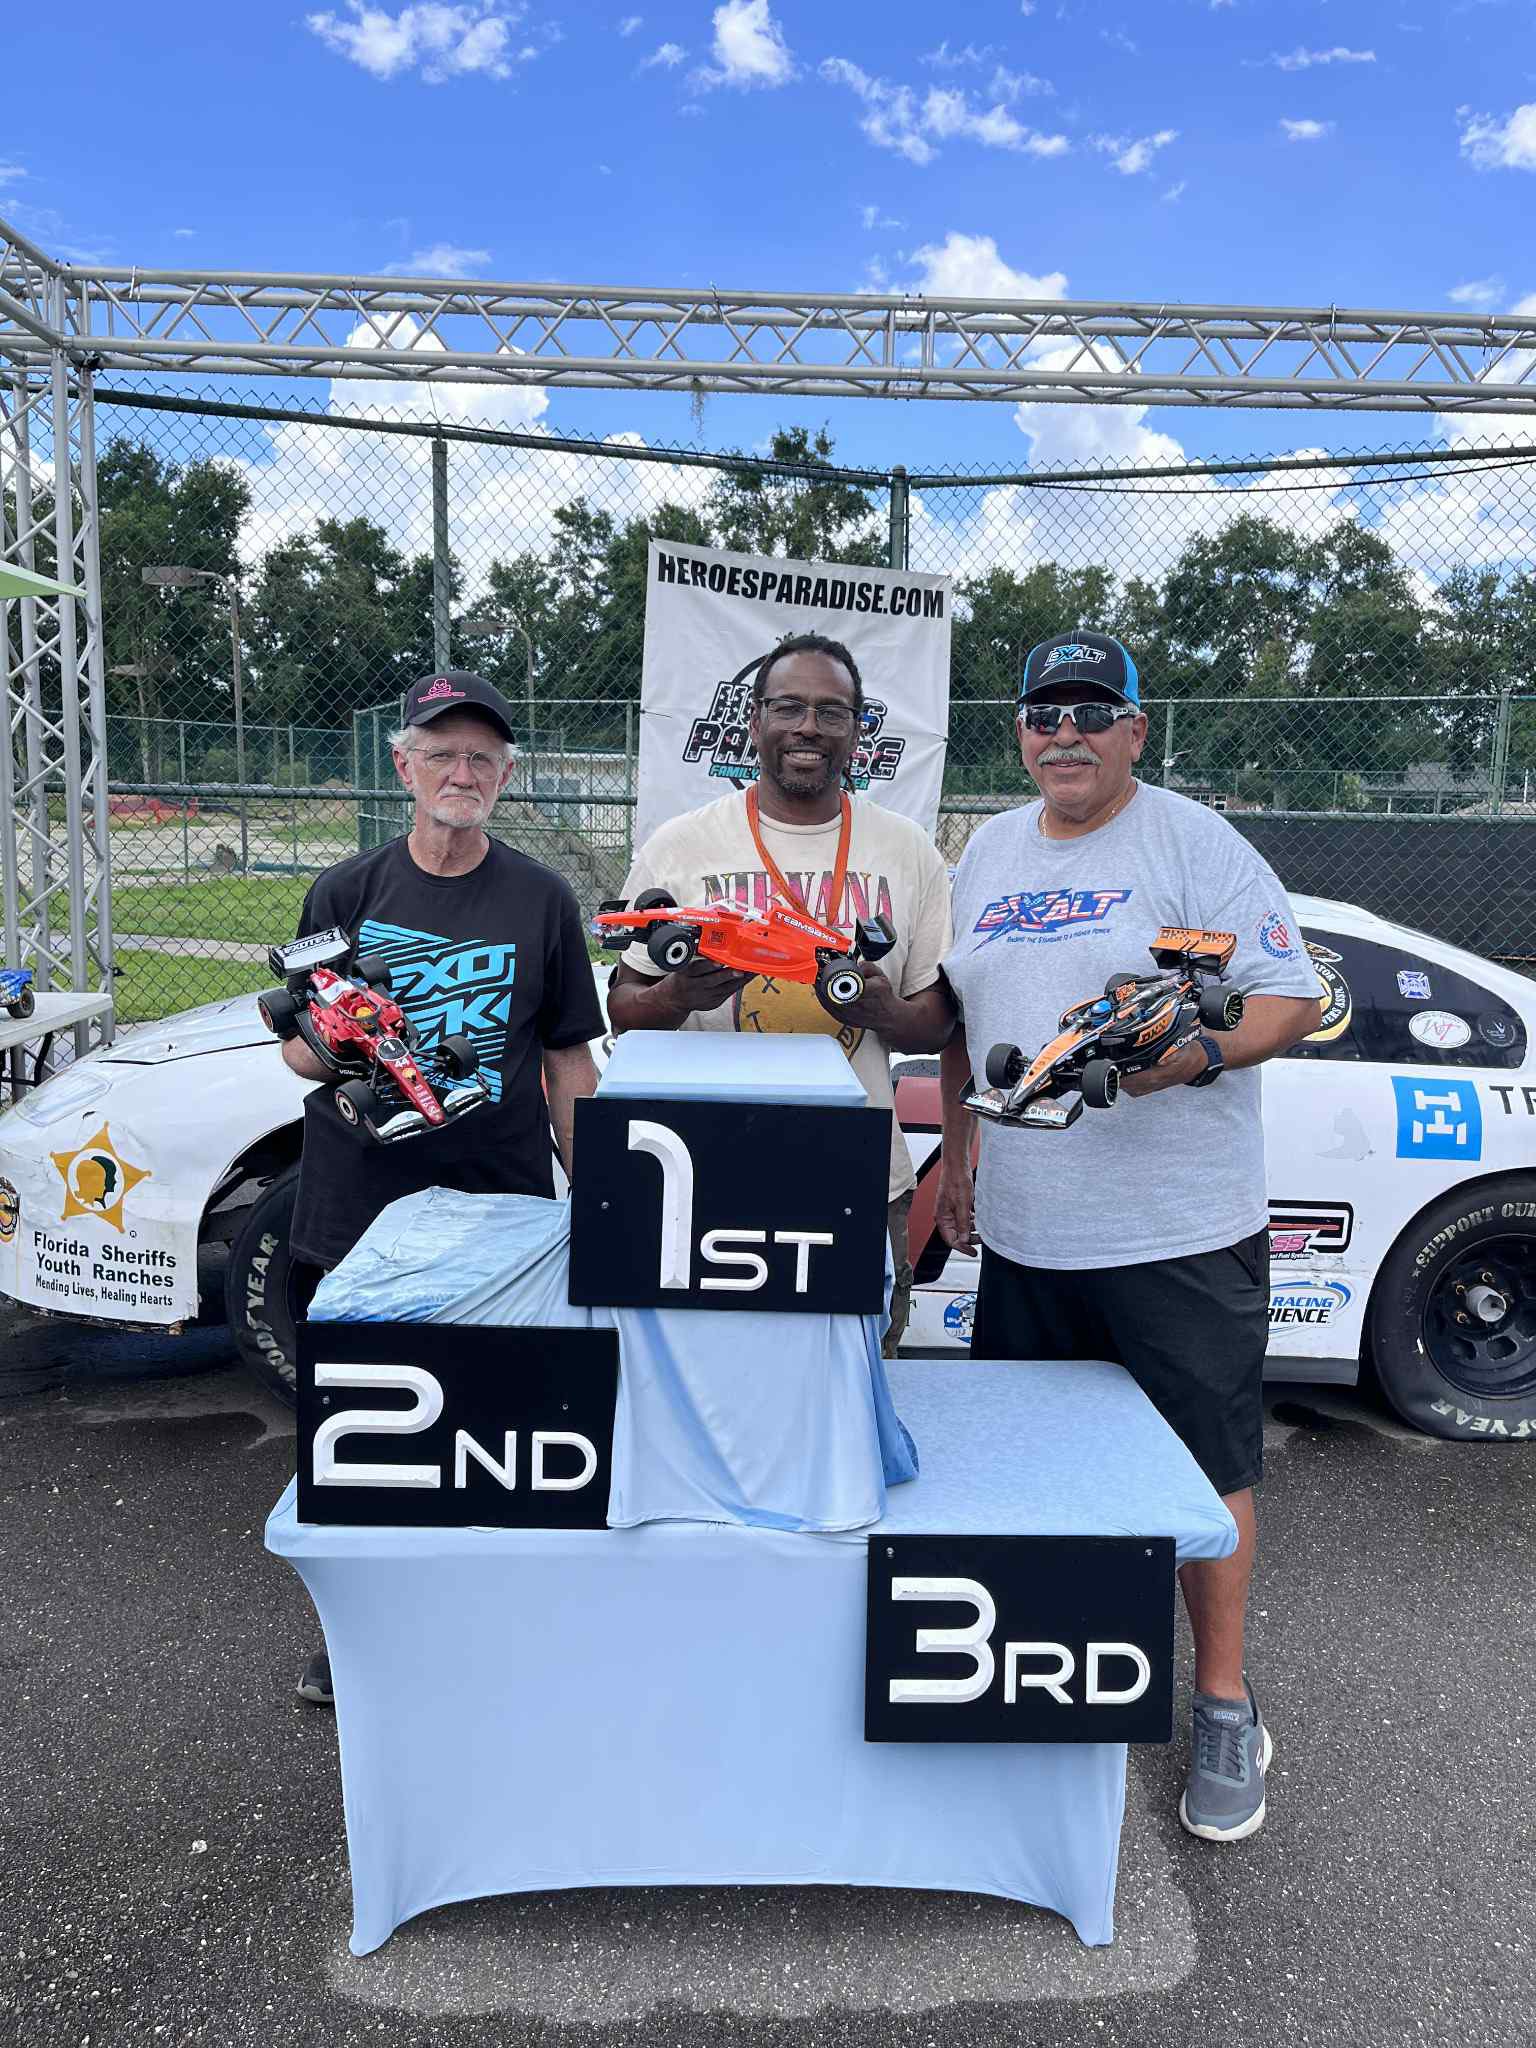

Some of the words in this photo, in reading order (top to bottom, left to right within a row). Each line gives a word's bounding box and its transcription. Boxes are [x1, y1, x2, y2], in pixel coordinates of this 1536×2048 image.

[657, 552, 945, 618] HEROESPARADISE.COM
[1044, 644, 1106, 668] EXALT
[683, 719, 904, 780] PASE
[973, 889, 1132, 933] EXALT
[1313, 961, 1337, 982] ATOR
[627, 1119, 834, 1293] 1ST
[34, 1231, 89, 1258] Florida
[101, 1244, 177, 1268] Sheriffs
[1415, 1205, 1495, 1268] SUPPORT
[35, 1274, 69, 1296] Mending
[72, 1281, 98, 1301] Lives,
[101, 1287, 137, 1306] Healing
[140, 1291, 173, 1306] Hearts
[36, 1252, 81, 1276] Youth
[93, 1263, 174, 1287] Ranches
[246, 1233, 297, 1391] OODYEAR
[1268, 1308, 1331, 1323] RIENCE
[1272, 1296, 1335, 1308] RACING
[313, 1362, 598, 1490] 2ND
[889, 1577, 1151, 1704] 3RD
